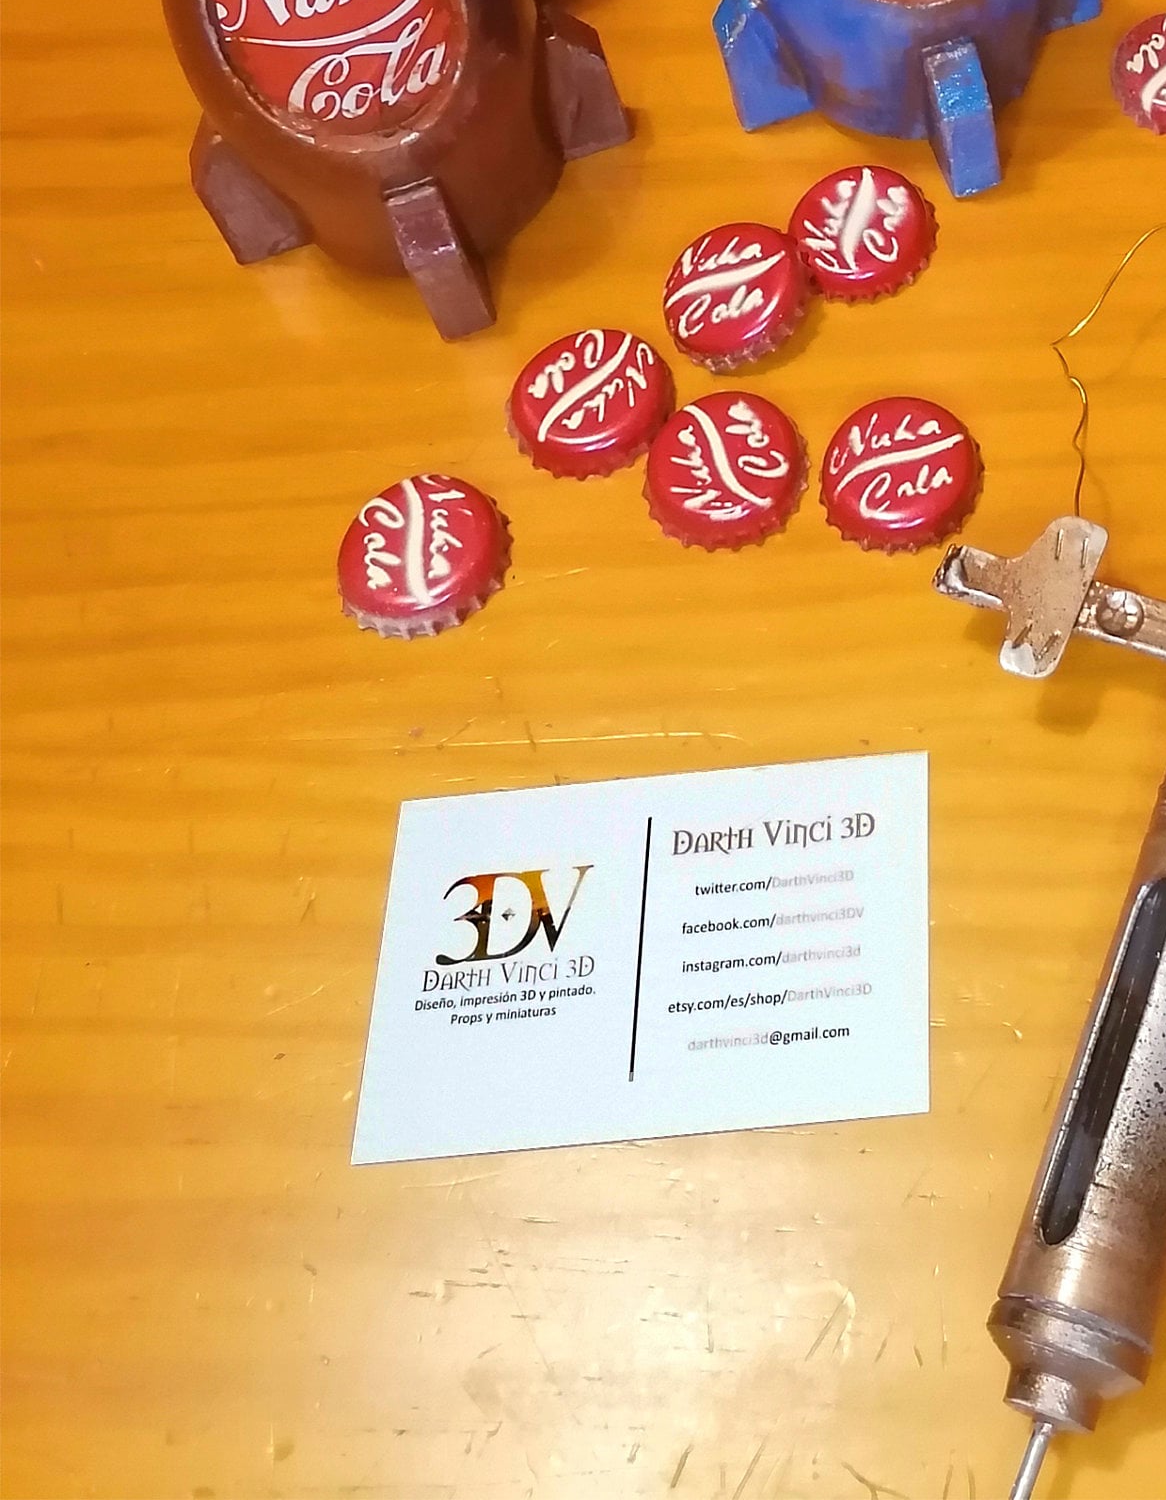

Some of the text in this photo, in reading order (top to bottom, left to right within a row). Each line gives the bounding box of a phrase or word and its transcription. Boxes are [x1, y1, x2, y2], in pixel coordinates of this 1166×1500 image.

[288, 8, 450, 121] Cola
[670, 236, 762, 286] Nuka
[678, 285, 764, 338] Cola
[528, 329, 604, 398] Cola
[561, 343, 654, 429] Nuka
[725, 400, 789, 478] Cola
[829, 413, 942, 475] Nuka
[859, 464, 953, 519] Cola
[359, 497, 405, 590] Cola
[840, 812, 875, 839] 3D
[565, 955, 596, 978] 3D
[415, 984, 596, 1011] Diseño, impresión 3D y pintado.
[450, 1006, 557, 1025] Props y miniaturas
